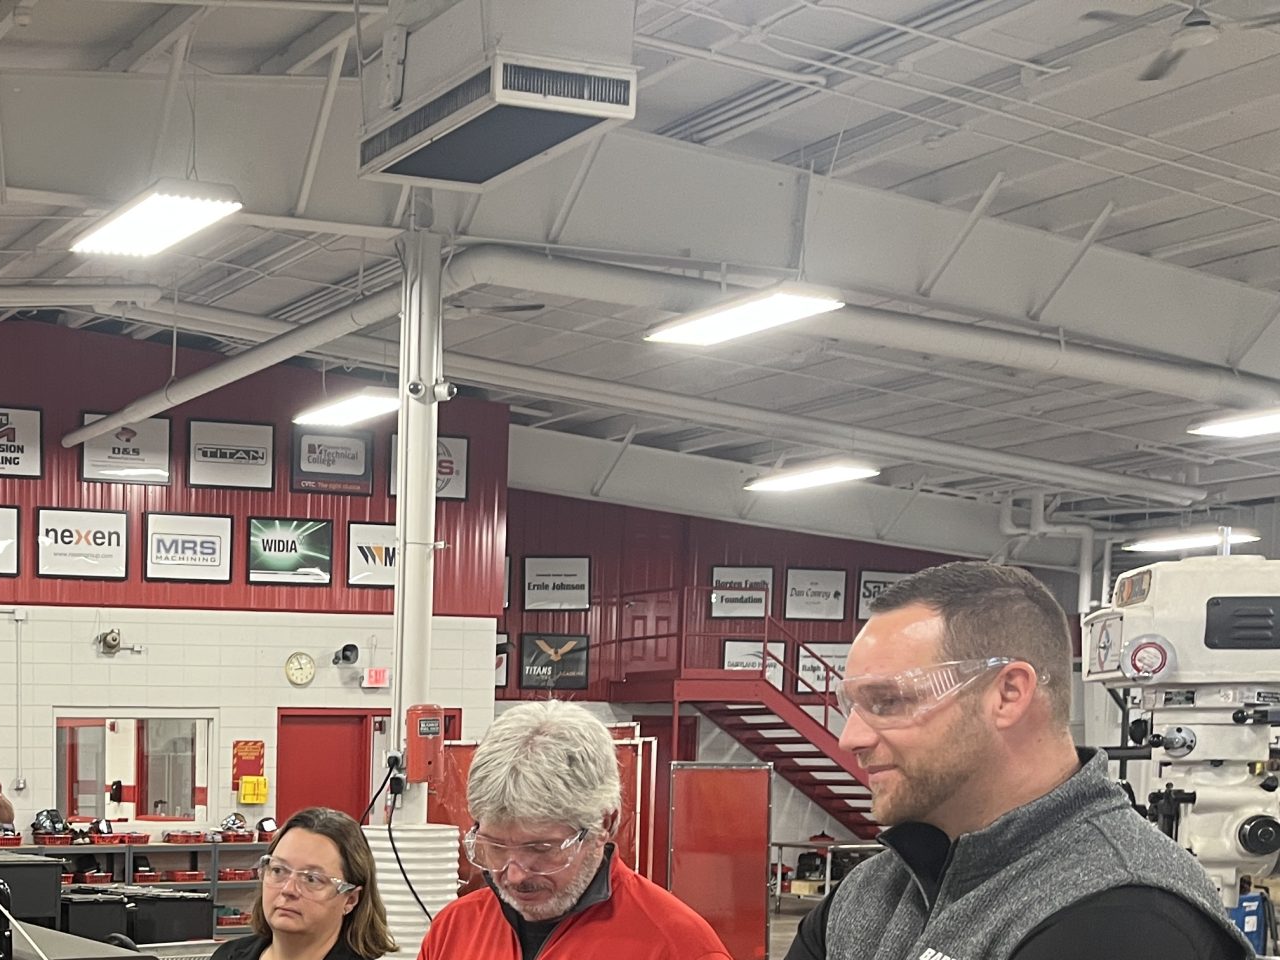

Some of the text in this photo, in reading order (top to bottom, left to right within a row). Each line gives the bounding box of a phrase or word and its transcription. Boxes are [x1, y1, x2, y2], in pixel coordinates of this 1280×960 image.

[201, 447, 265, 462] TITAN
[323, 449, 359, 461] Technical
[307, 455, 337, 468] College
[45, 527, 121, 547] nexen
[156, 538, 217, 556] MRS
[261, 538, 298, 553] WIDIA
[155, 555, 217, 563] MACHINING
[527, 581, 586, 591] Ernie Johnson
[789, 587, 805, 597] Dan
[720, 595, 763, 604] Foundation
[524, 665, 553, 676] TITANS
